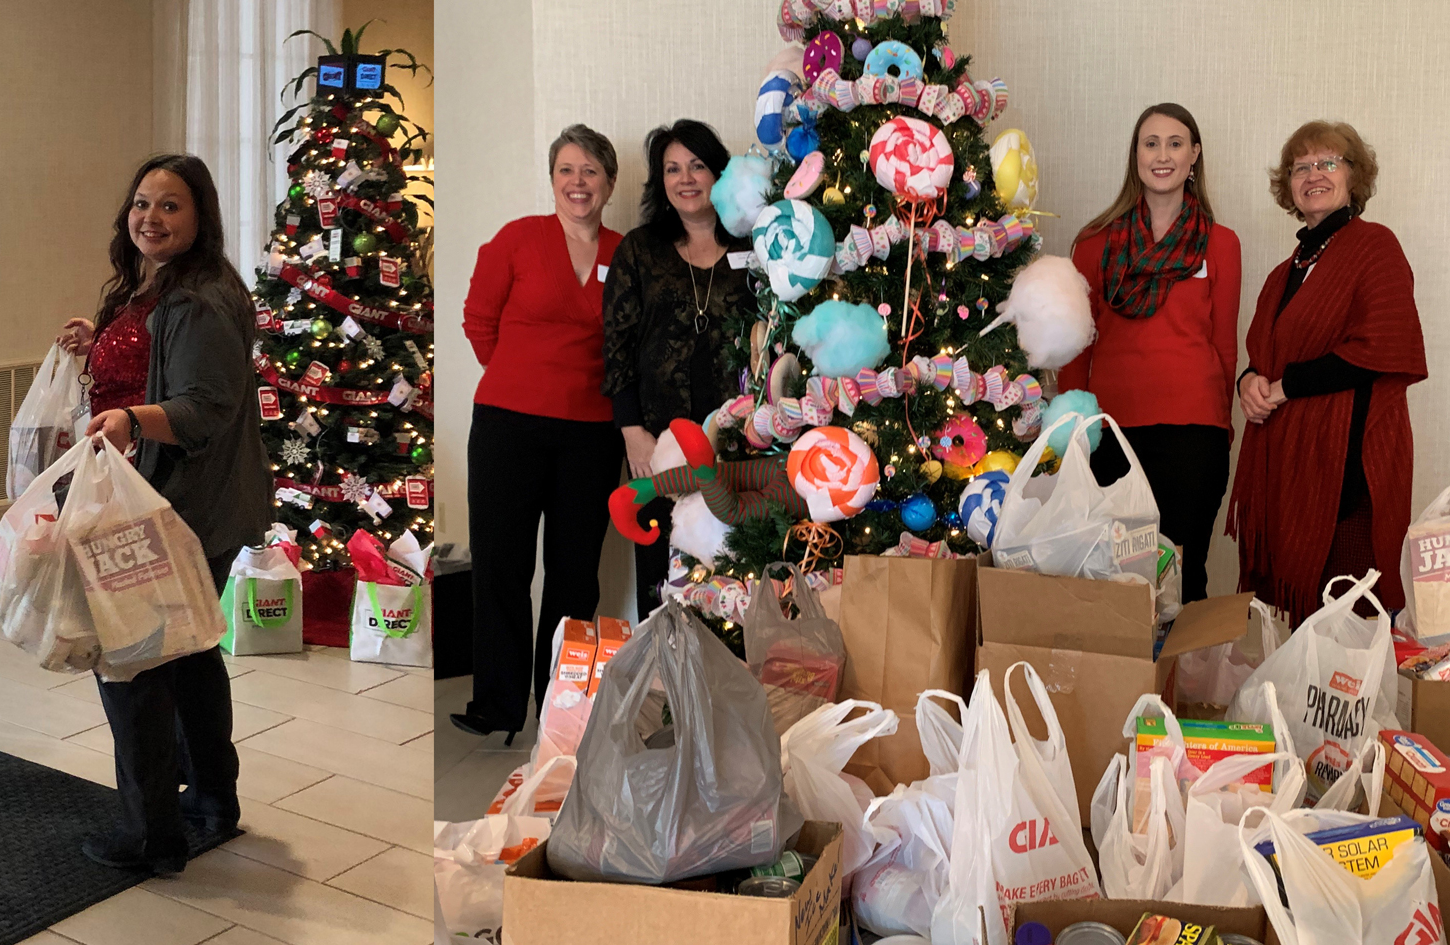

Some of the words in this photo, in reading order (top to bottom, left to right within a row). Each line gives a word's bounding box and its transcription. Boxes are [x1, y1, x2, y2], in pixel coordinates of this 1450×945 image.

[349, 303, 389, 321] GIANT
[278, 378, 320, 396] GIANT
[1131, 531, 1156, 554] RIGATI
[1418, 535, 1450, 552] HUN
[95, 538, 159, 577] ACK
[246, 607, 288, 619] DRECT
[368, 617, 412, 629] DRECT
[568, 649, 589, 659] weis
[1334, 674, 1361, 690] wei
[1208, 742, 1219, 751] of
[1221, 743, 1258, 753] America
[1337, 837, 1389, 859] SOLAR
[1339, 855, 1380, 873] STEM
[1059, 870, 1079, 889] BAG
